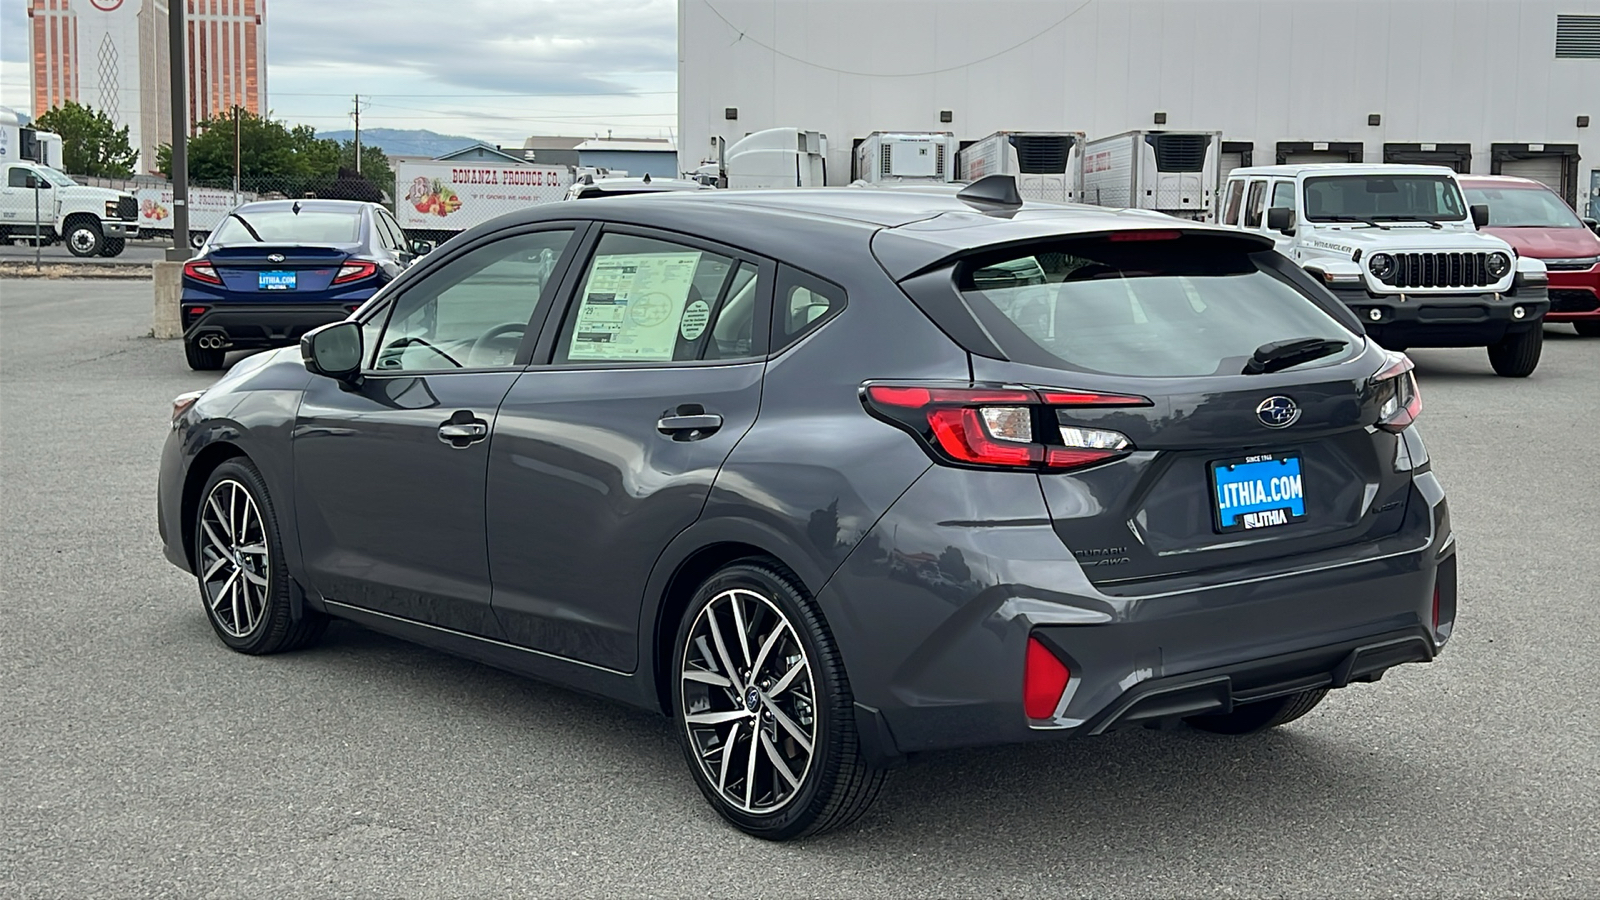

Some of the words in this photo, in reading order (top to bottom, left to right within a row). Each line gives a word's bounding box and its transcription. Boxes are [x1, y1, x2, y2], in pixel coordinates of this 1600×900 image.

[452, 168, 498, 185] BONANZA
[503, 170, 542, 186] PRODUCE
[547, 172, 561, 187] CO.
[1313, 240, 1352, 253] WRANGLER
[259, 276, 296, 284] LITHIA.COM
[1245, 455, 1261, 464] SINCE
[1217, 474, 1303, 510] LITHIA.COM
[1253, 509, 1288, 528] LITHIA
[1074, 547, 1127, 557] SUBARU
[1096, 557, 1131, 566] AWD
